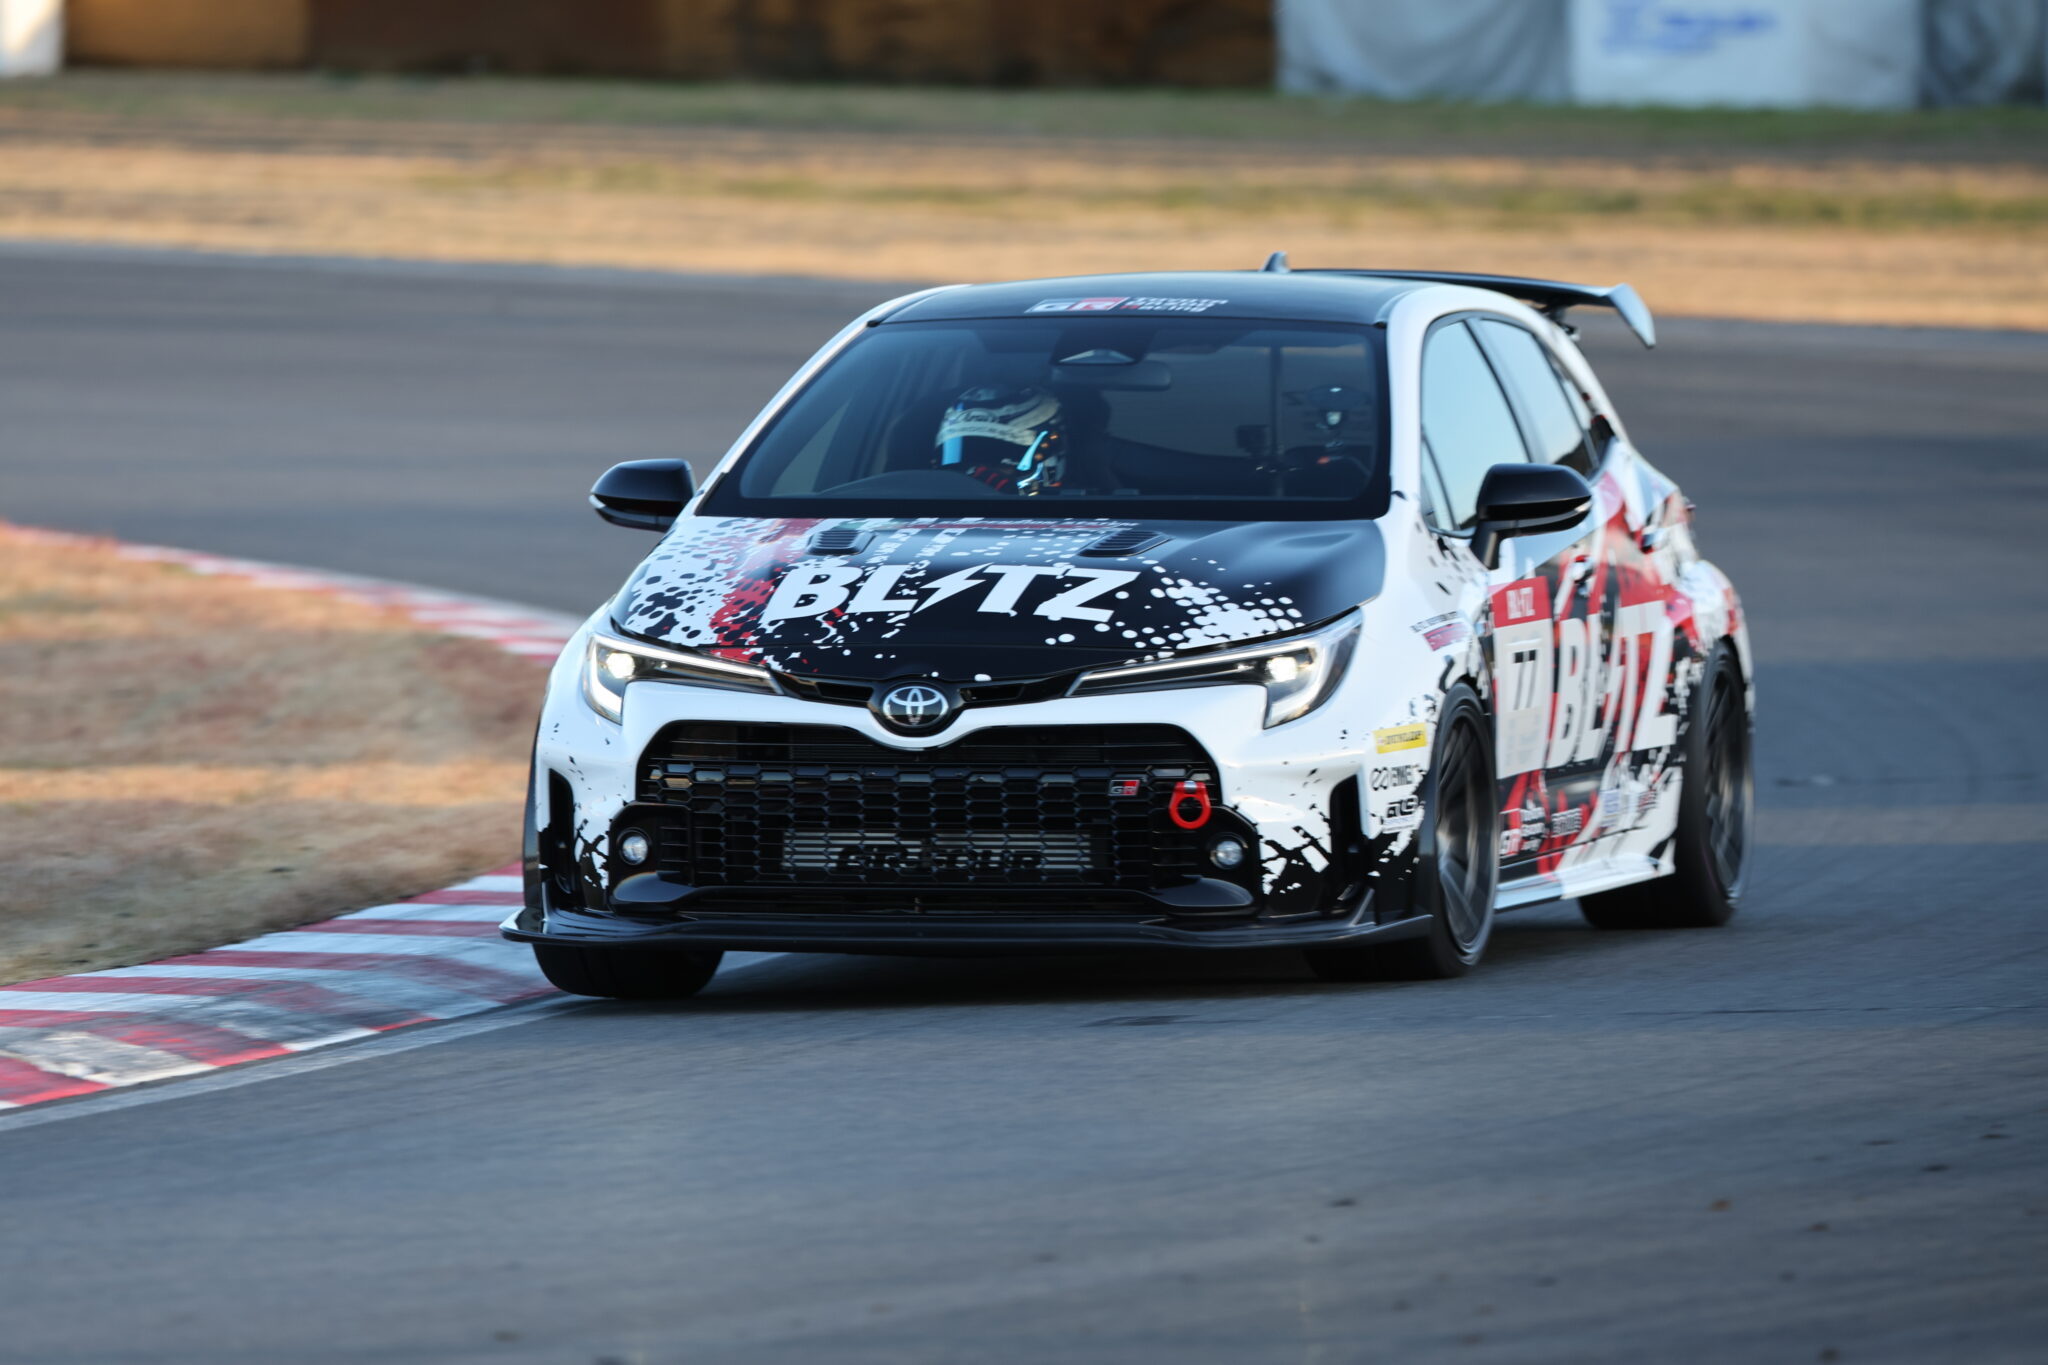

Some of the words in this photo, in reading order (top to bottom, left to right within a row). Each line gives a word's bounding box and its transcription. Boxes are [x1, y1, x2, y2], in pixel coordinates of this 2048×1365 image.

[1026, 298, 1124, 312] GR
[758, 562, 1141, 622] BLITZ
[1547, 601, 1678, 769] BLITZ
[1110, 782, 1138, 795] GR
